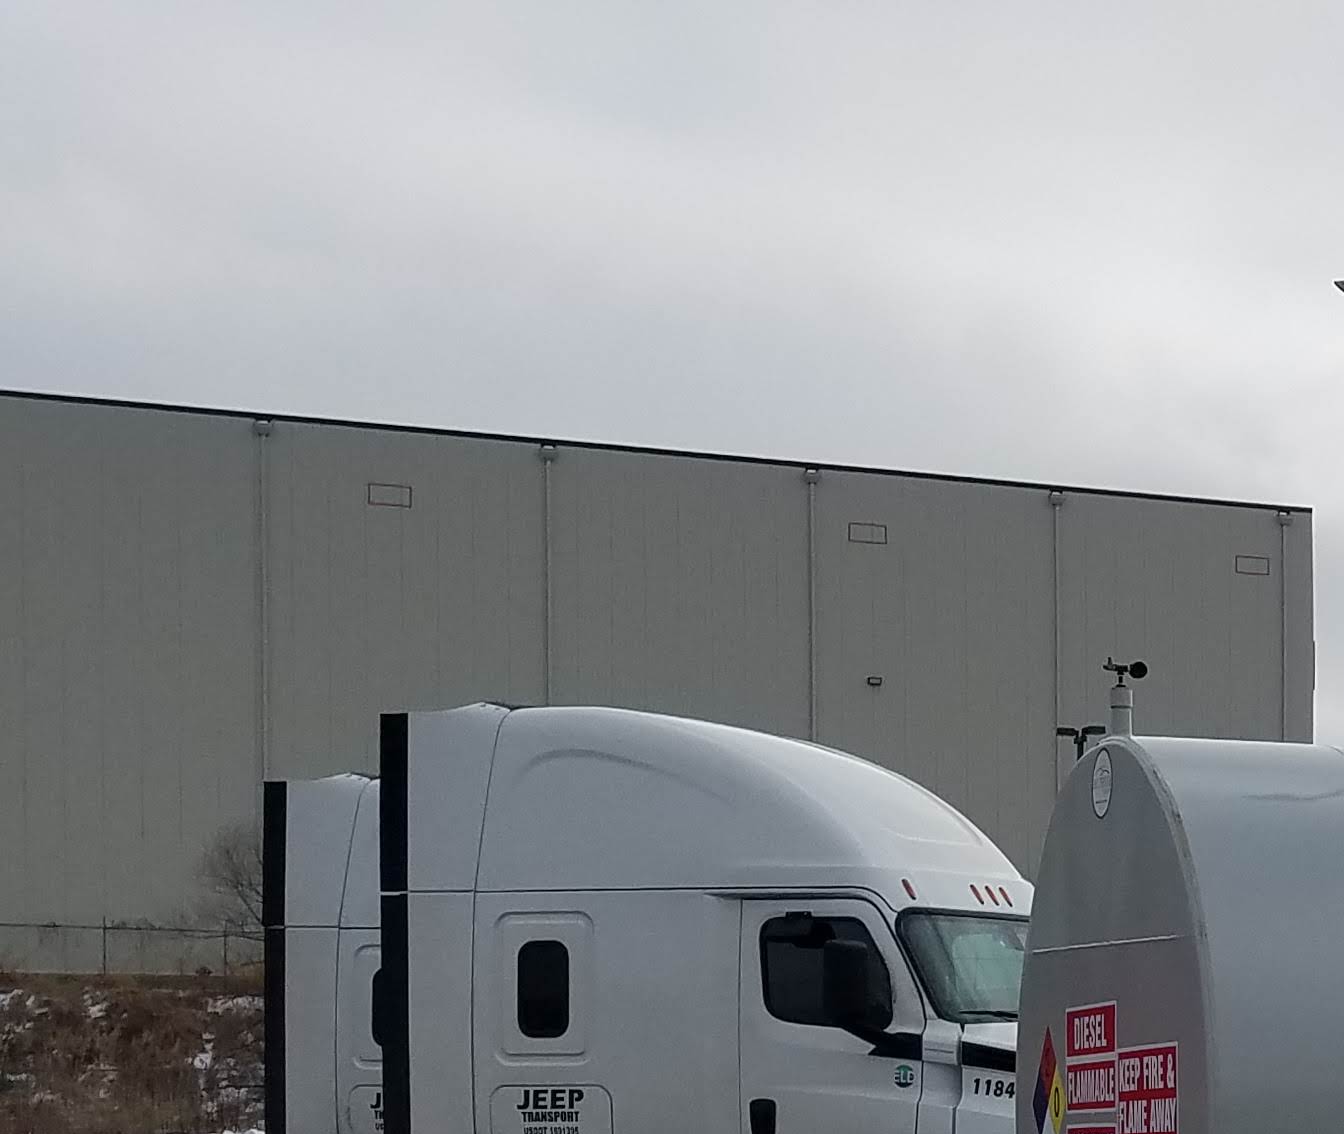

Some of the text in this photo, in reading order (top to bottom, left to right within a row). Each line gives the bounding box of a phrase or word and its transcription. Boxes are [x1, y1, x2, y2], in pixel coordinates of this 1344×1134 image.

[1074, 1013, 1107, 1050] DIESEL
[973, 1078, 1016, 1099] 1184
[1068, 1067, 1114, 1105] FLAMMABLE
[1119, 1053, 1175, 1092] KEEP FIRE &
[517, 1089, 584, 1109] JEEP
[1054, 1086, 1060, 1118] 0
[1119, 1098, 1177, 1134] FLAME AWAY
[521, 1111, 580, 1122] TRANSPORT
